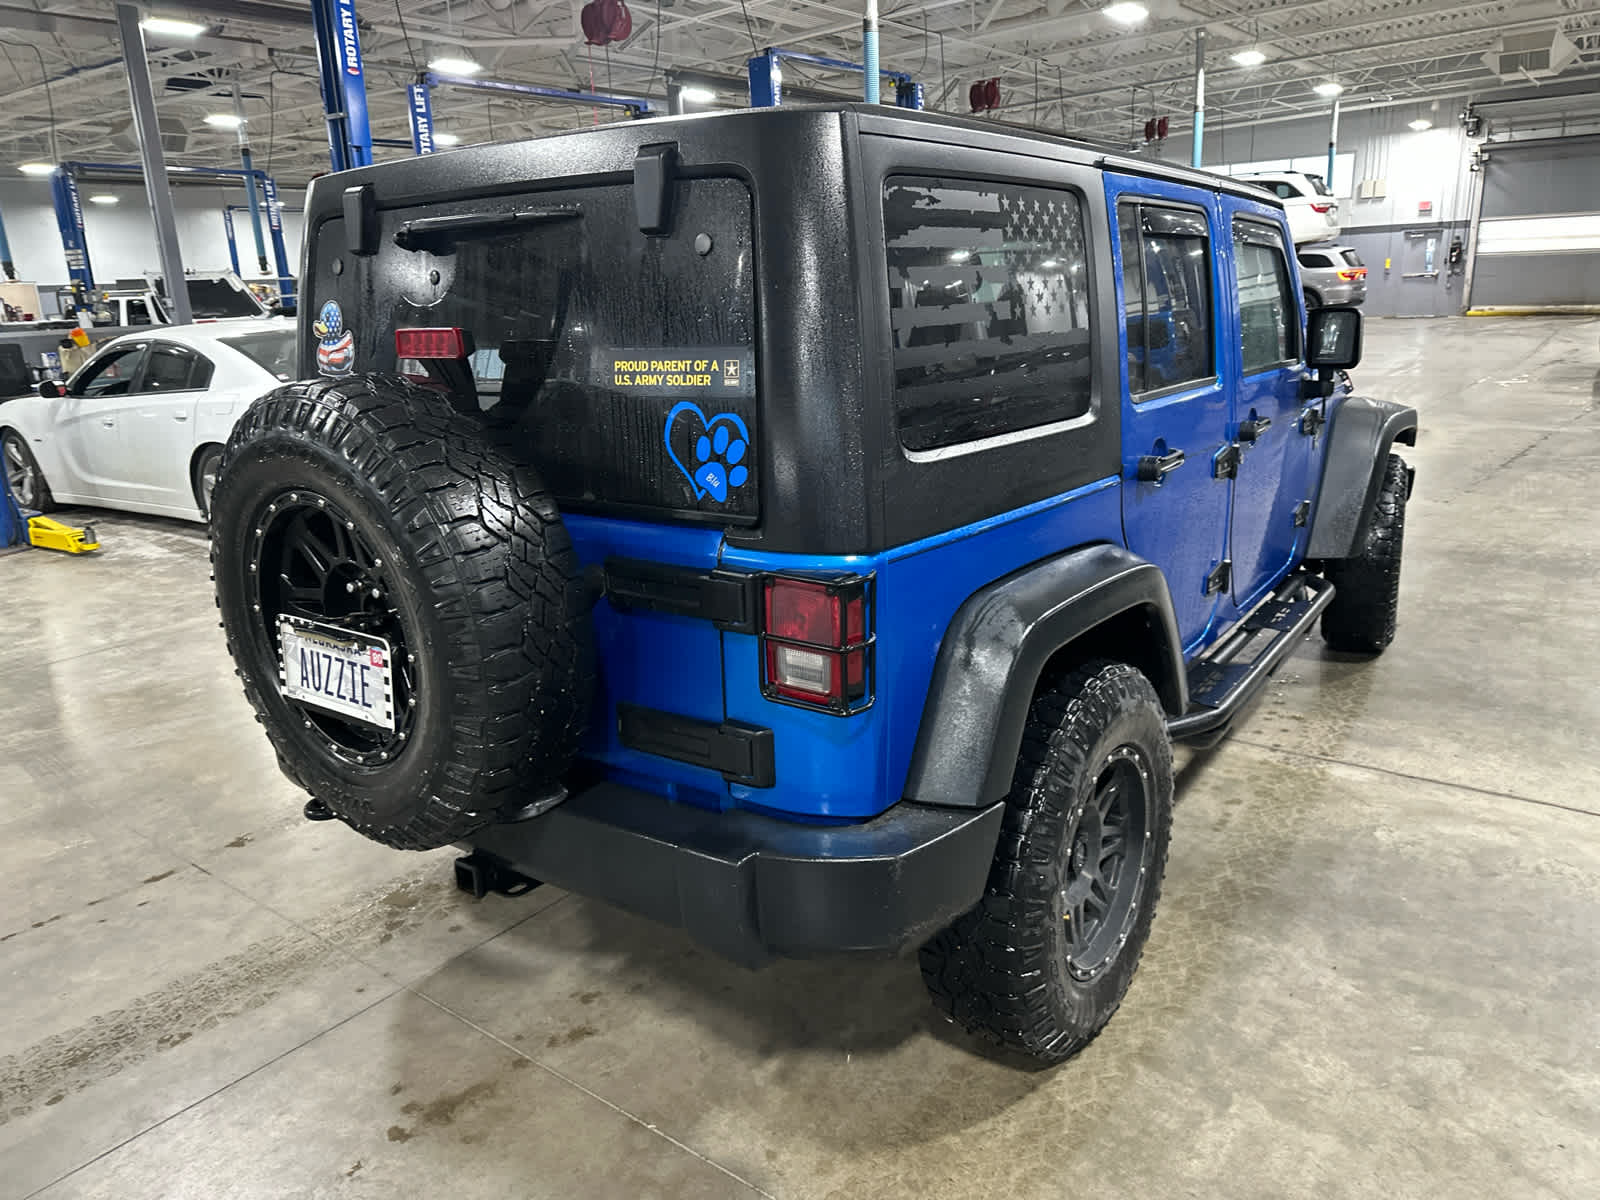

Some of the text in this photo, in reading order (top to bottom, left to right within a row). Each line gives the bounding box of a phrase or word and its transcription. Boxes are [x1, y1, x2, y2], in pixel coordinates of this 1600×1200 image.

[340, 7, 359, 68] ROTARY
[413, 85, 432, 154] OTARY LIFT
[614, 360, 719, 372] PROUD PARENT OF A
[614, 374, 633, 386] U.S.
[634, 374, 665, 386] ARMY
[666, 374, 711, 386] SOLDIER
[300, 647, 372, 708] AUZZIE
